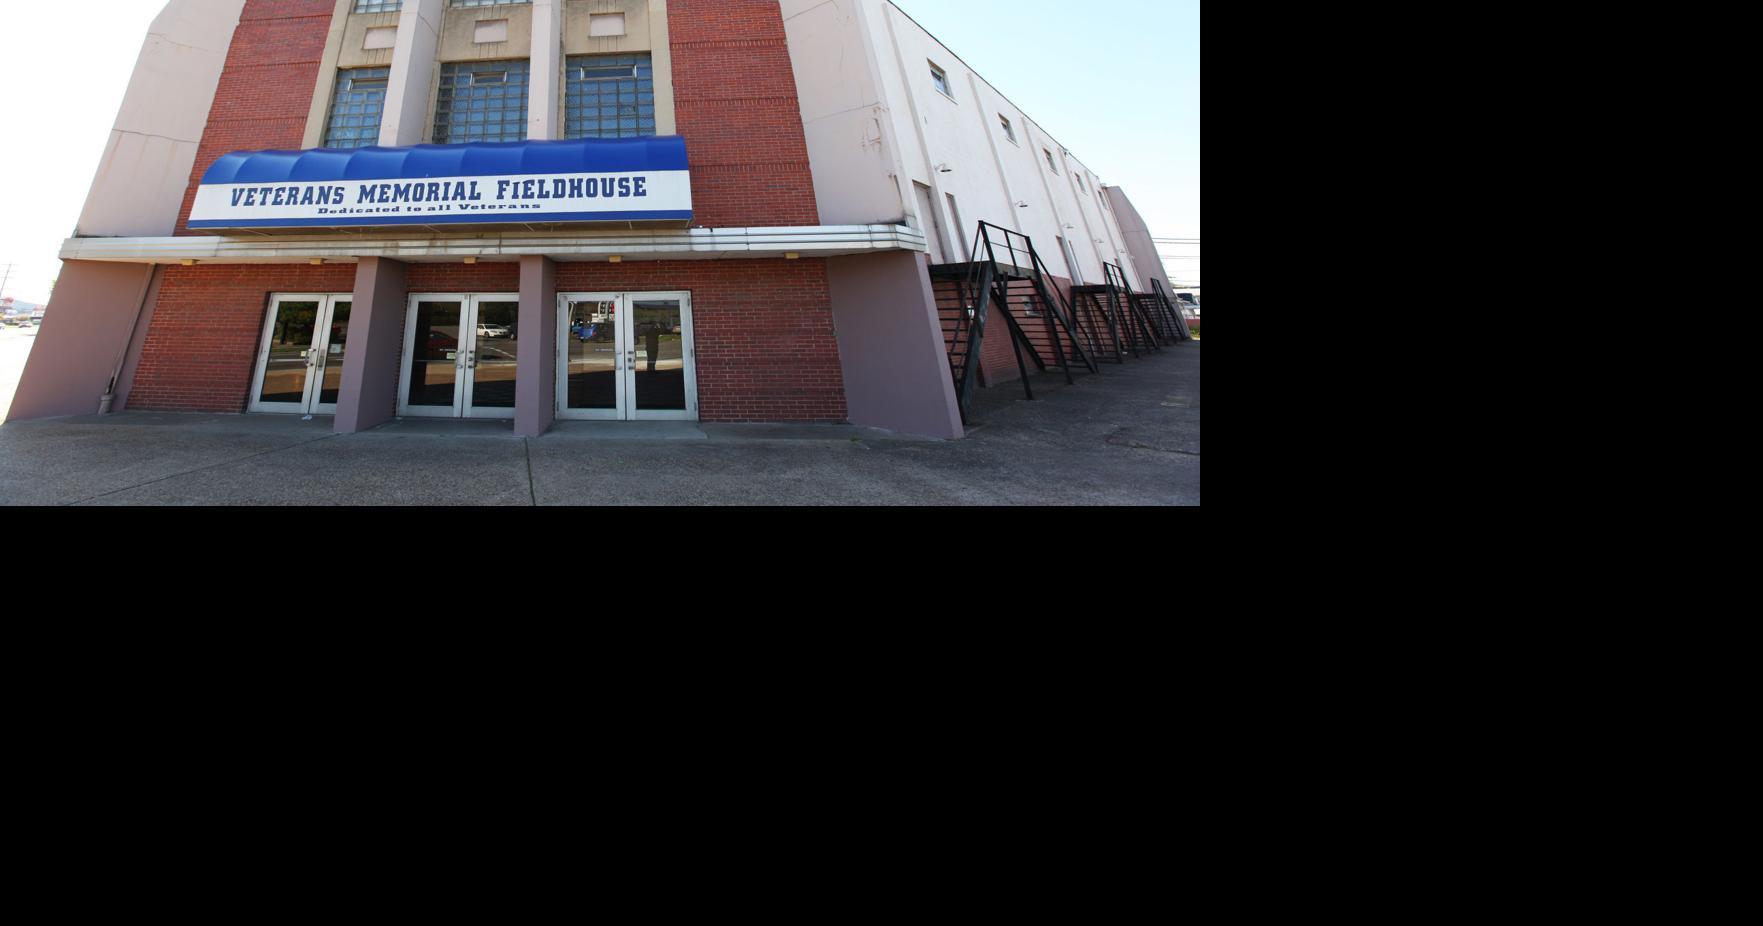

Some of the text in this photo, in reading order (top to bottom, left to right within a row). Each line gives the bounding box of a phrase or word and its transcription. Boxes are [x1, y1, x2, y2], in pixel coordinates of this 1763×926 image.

[231, 176, 647, 206] VETERANS MEMORIAL FIELDHOUSE
[317, 206, 400, 214] Dedicated
